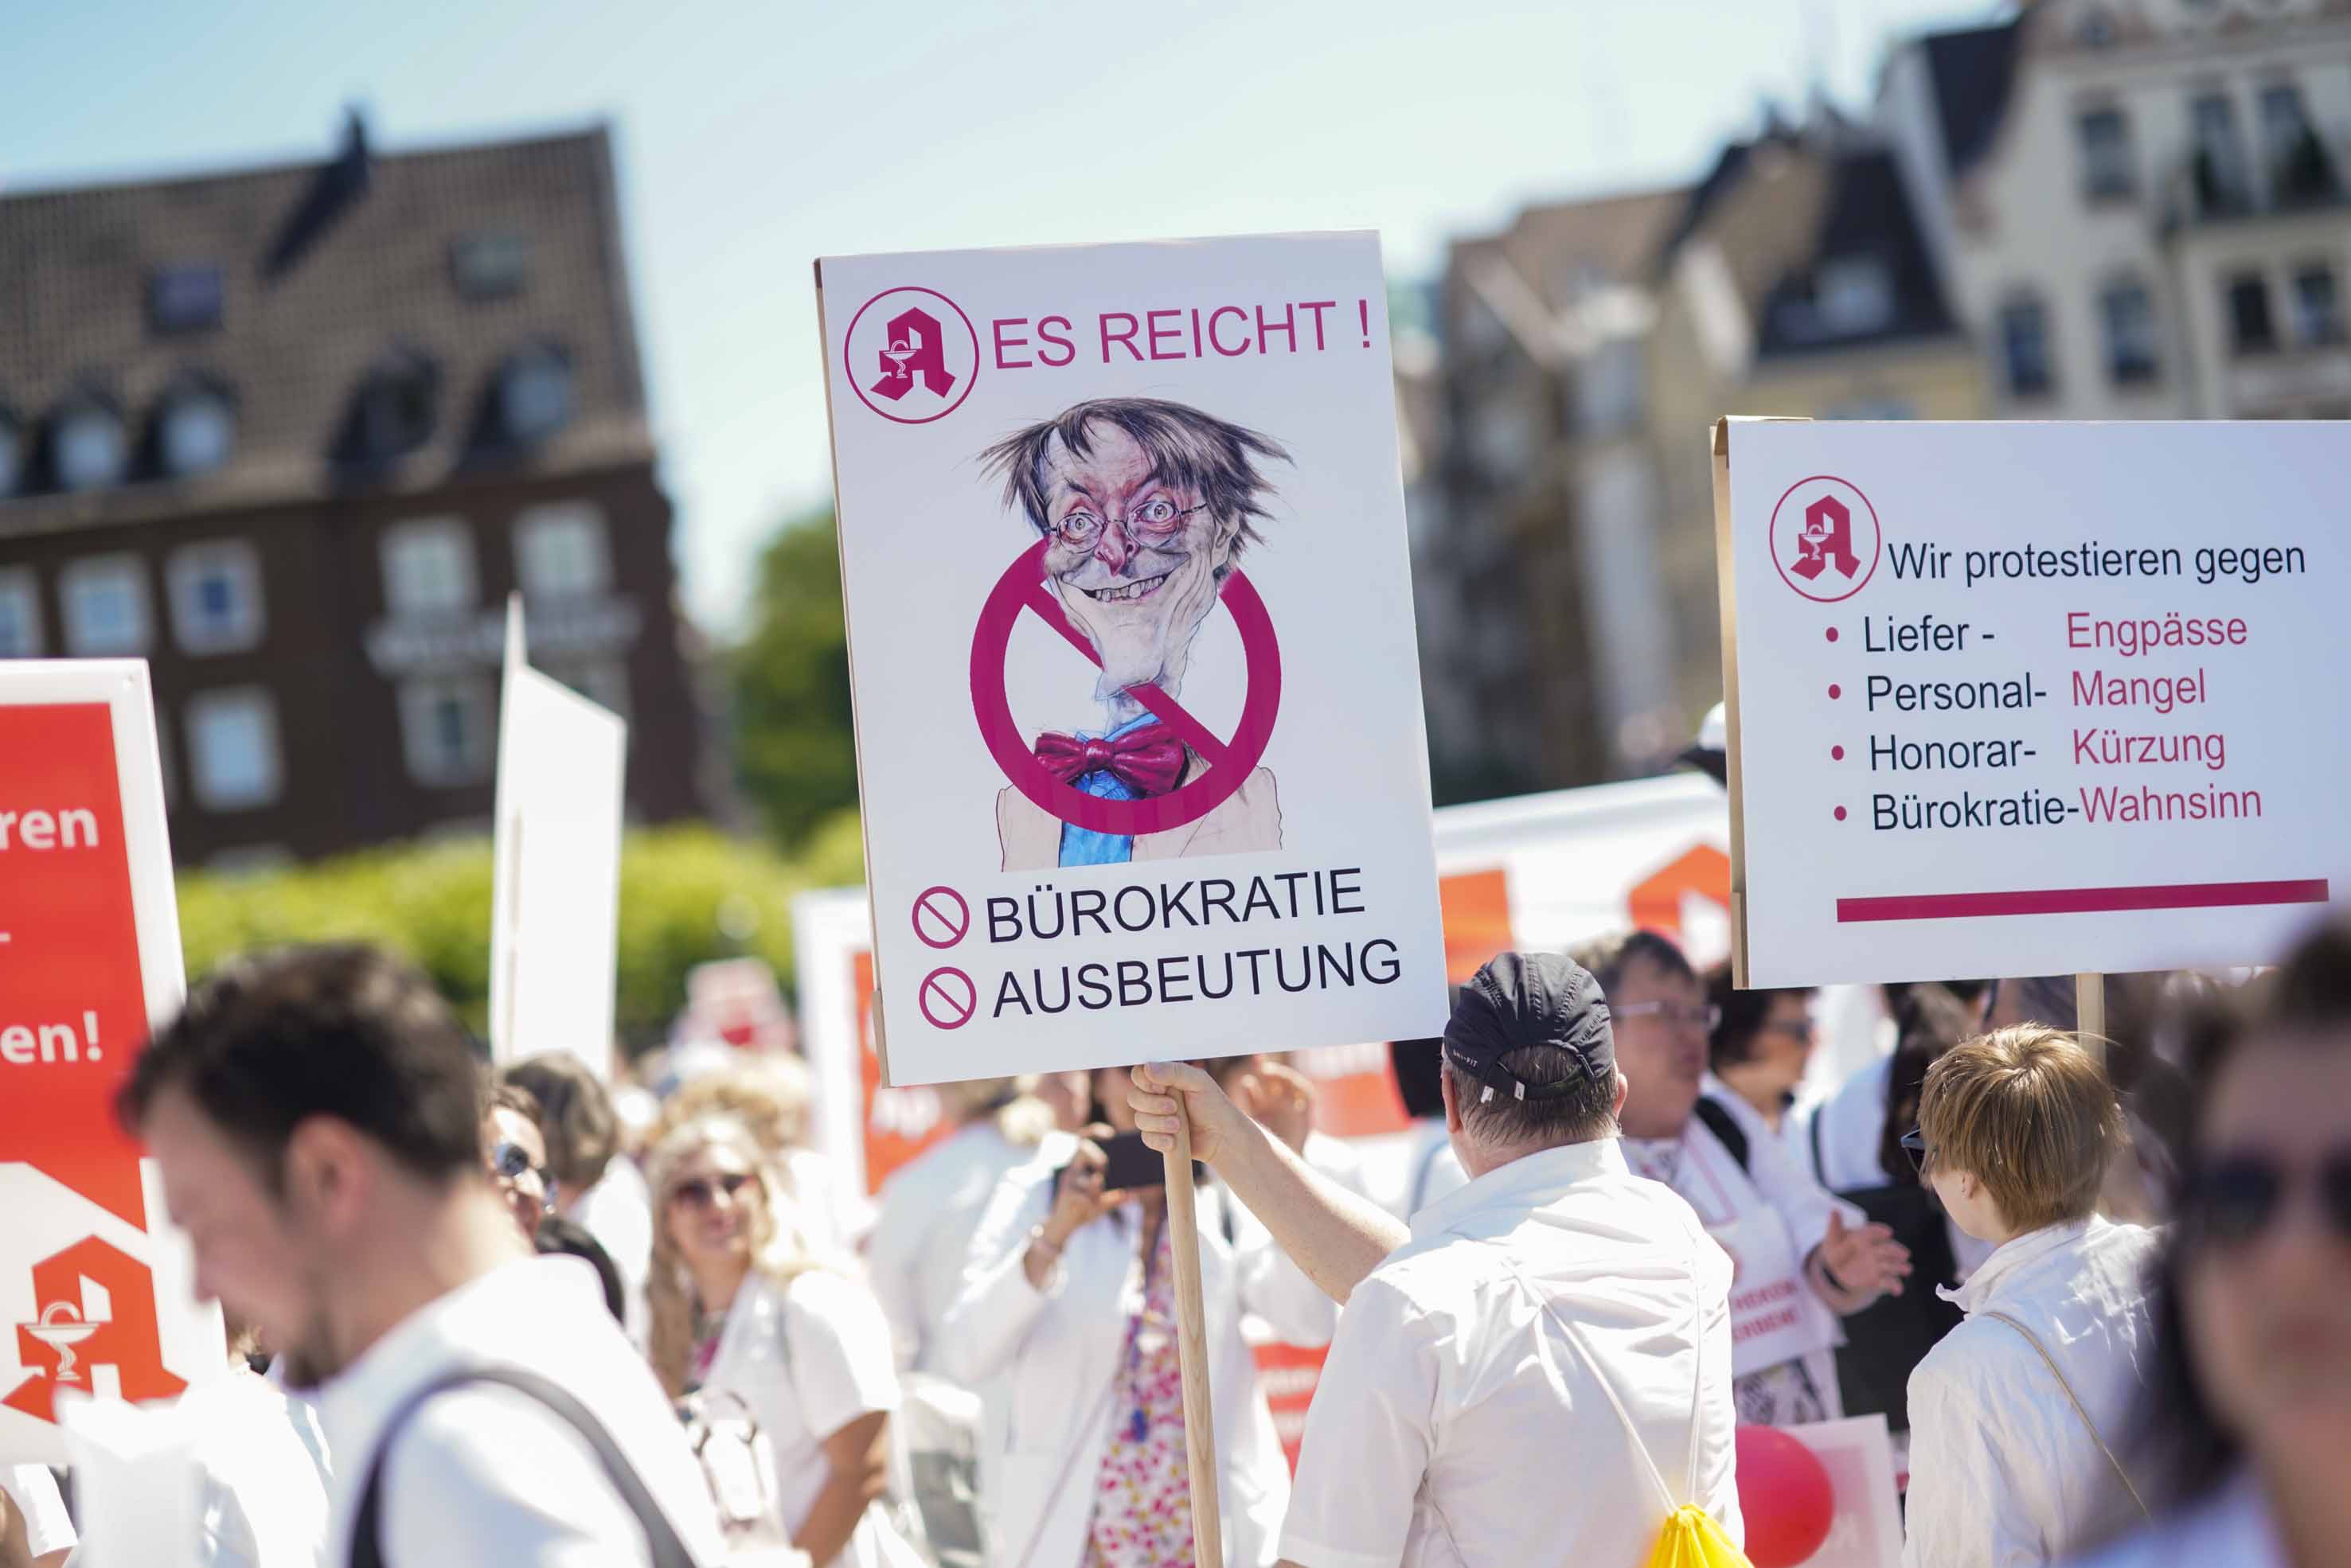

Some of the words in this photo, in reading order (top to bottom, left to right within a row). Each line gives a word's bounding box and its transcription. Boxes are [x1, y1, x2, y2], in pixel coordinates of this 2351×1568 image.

[992, 315, 1076, 370] ES
[1099, 300, 1337, 364] REICHT
[1887, 542, 1953, 579] Wir
[1965, 540, 2182, 588] protestieren
[2195, 546, 2306, 585] gegen
[2067, 611, 2248, 657] Engpässe
[1867, 672, 2047, 712] Personal-
[2072, 667, 2206, 714] Mangel
[1870, 735, 2037, 771] Honorar-
[2073, 727, 2226, 770] Kürzung
[986, 867, 1365, 944] BÜROKRATIE
[992, 938, 1401, 1019] AUSBEUTUNG
[0, 1010, 103, 1063] en!
